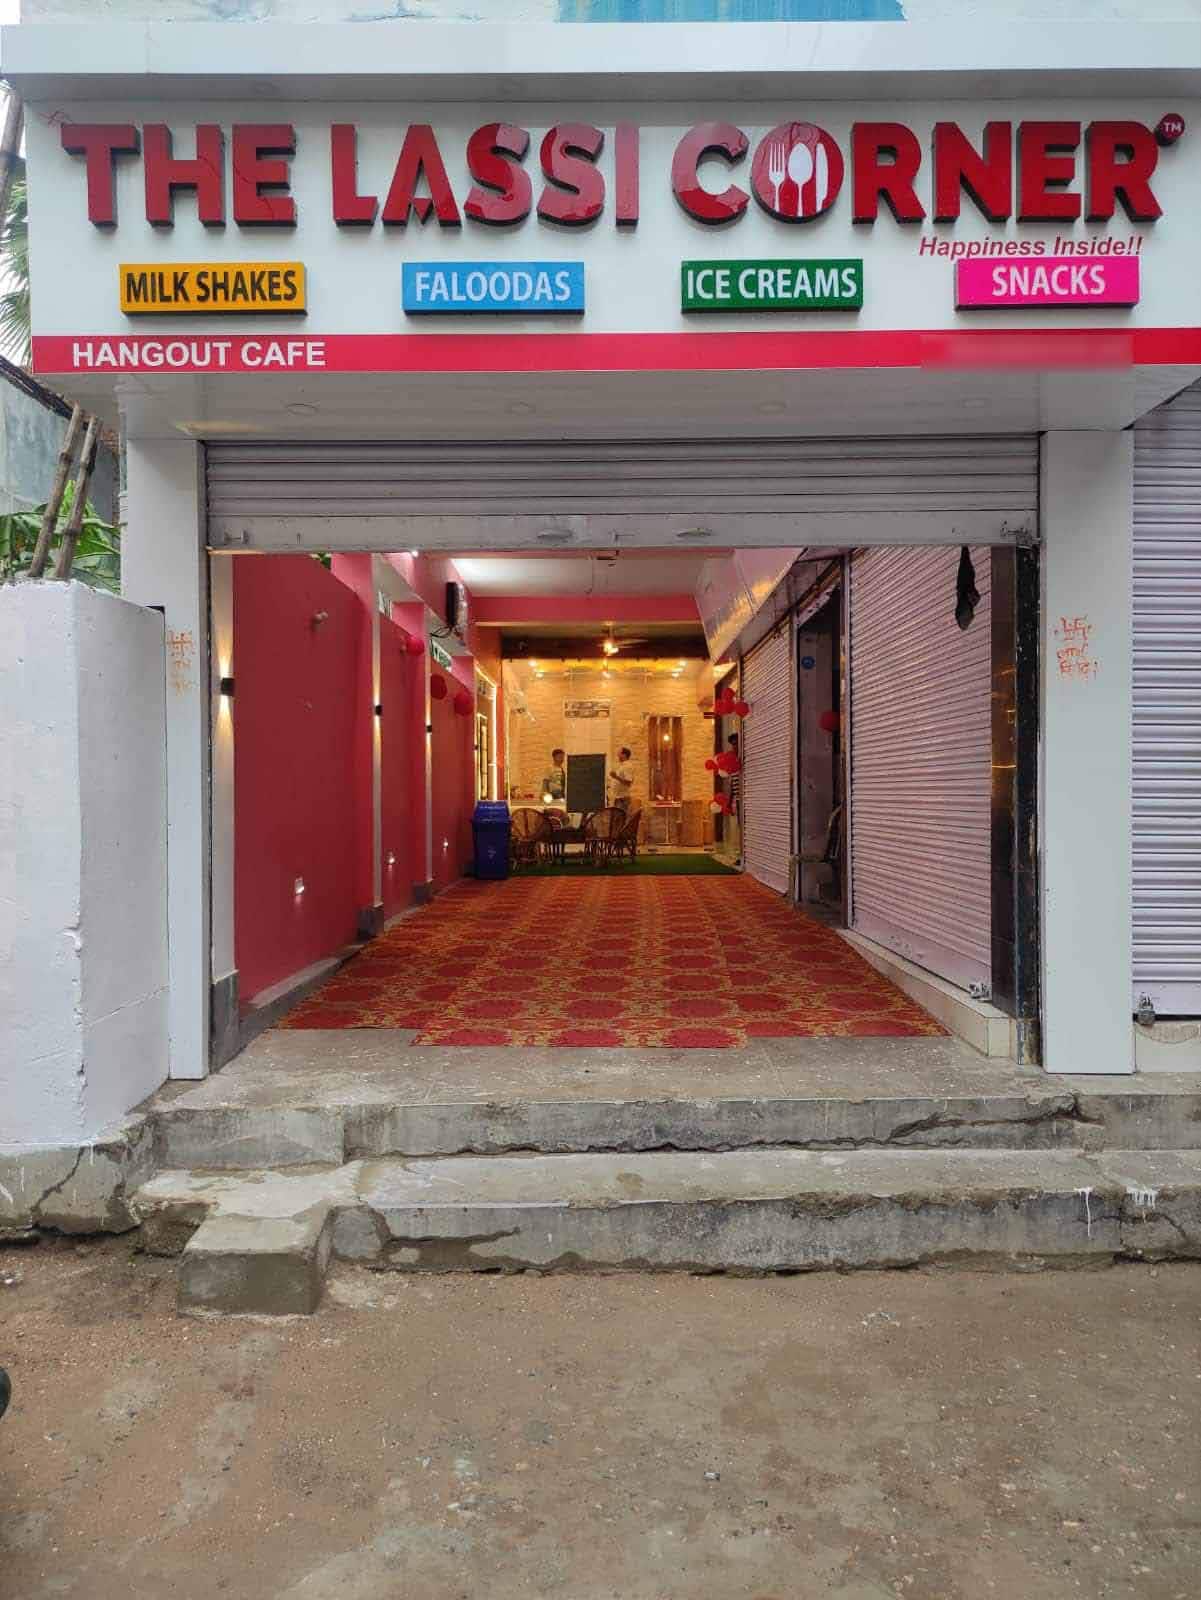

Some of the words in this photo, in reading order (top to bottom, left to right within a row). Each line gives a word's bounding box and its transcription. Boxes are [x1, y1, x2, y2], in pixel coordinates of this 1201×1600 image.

[61, 123, 297, 227] THE
[331, 122, 640, 228] LASSI
[671, 120, 1163, 224] CORNER
[919, 236, 1045, 260] Happiness
[1054, 235, 1143, 257] Inside!!
[126, 272, 189, 303] MILK
[196, 269, 298, 301] SHAKES
[415, 270, 571, 303] FALOODAS
[687, 269, 730, 300] ICE
[737, 267, 857, 299] CREAMS
[991, 264, 1106, 297] SNACKS
[72, 342, 232, 368] HANGOUT
[241, 341, 326, 367] CAFE
